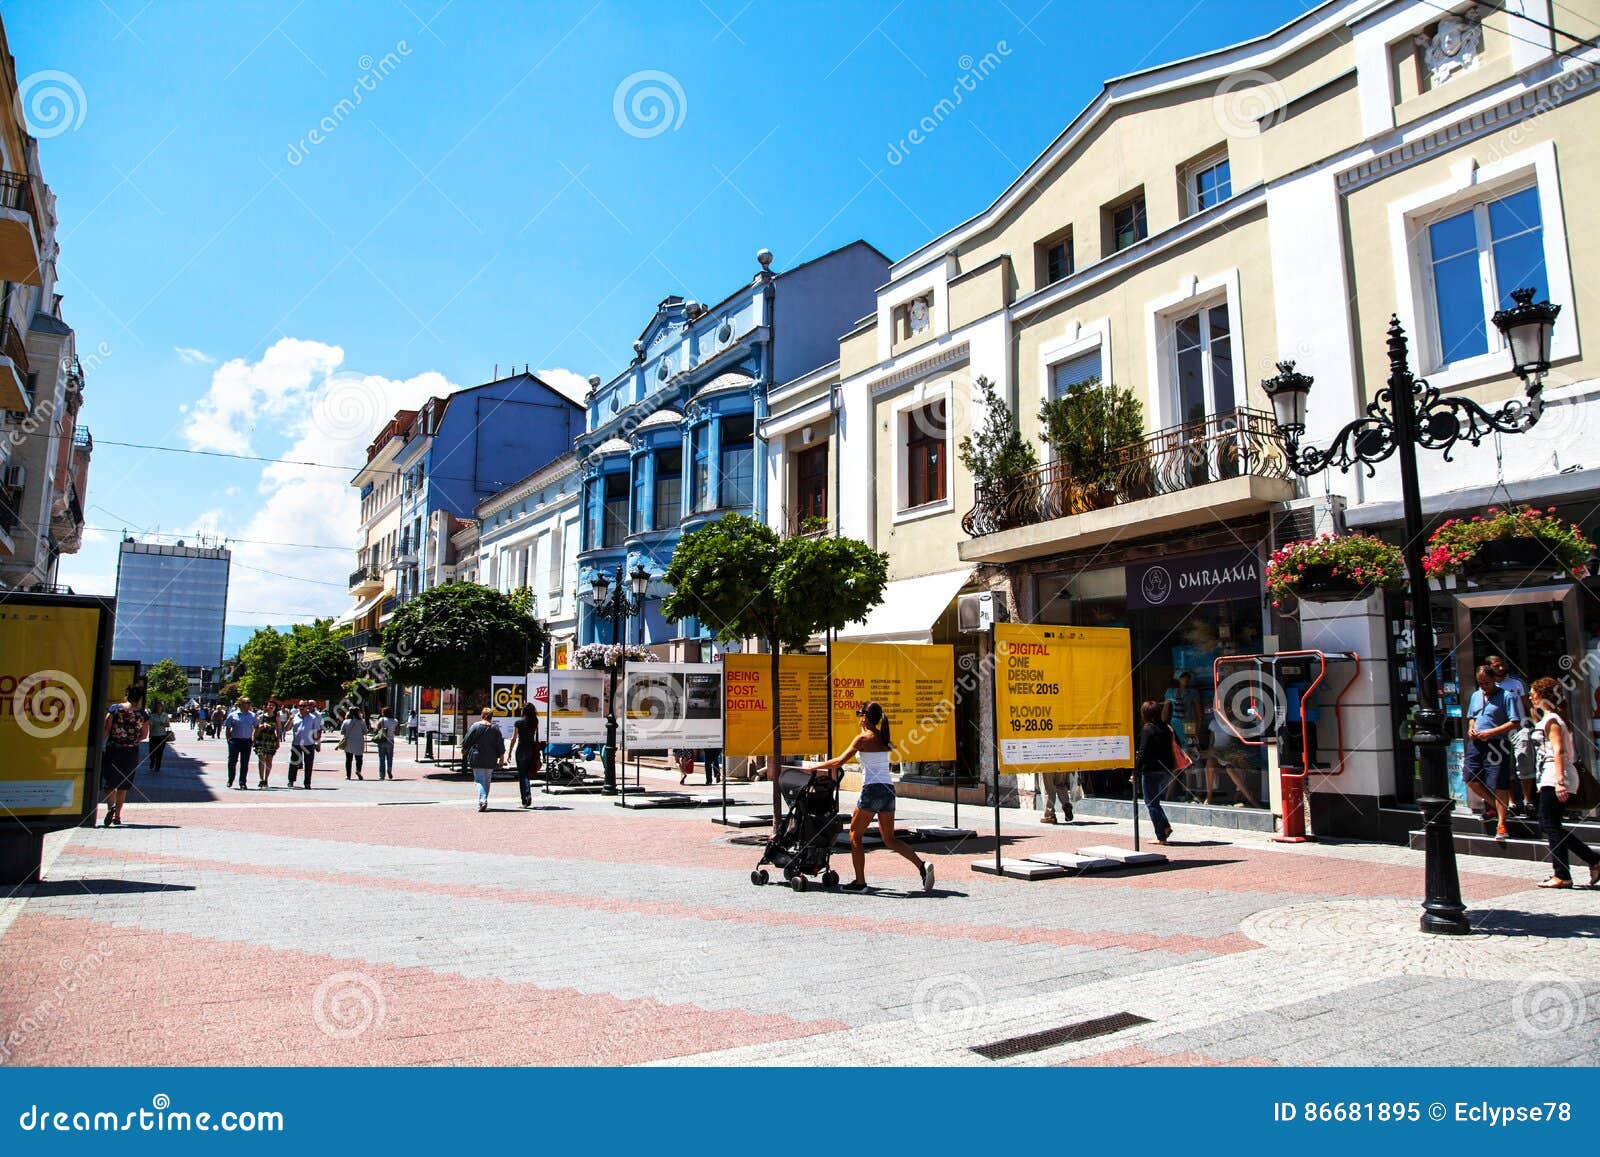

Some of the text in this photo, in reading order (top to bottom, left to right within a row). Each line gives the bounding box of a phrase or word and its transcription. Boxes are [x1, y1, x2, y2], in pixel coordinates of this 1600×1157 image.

[1179, 563, 1257, 589] OMRAAMA
[1008, 643, 1050, 656] DIGITAL
[1008, 656, 1030, 668] ONE
[726, 671, 760, 681] BEING
[1008, 669, 1044, 681] DESIGN
[833, 678, 865, 688] ФОРУМ
[1008, 683, 1060, 695] WEEK 2015
[726, 685, 759, 696] POST-
[833, 689, 855, 699] 27.06
[726, 699, 768, 710] DIGITAL
[1009, 706, 1052, 718] PLOVDIV
[1009, 719, 1054, 732] 19-28.06
